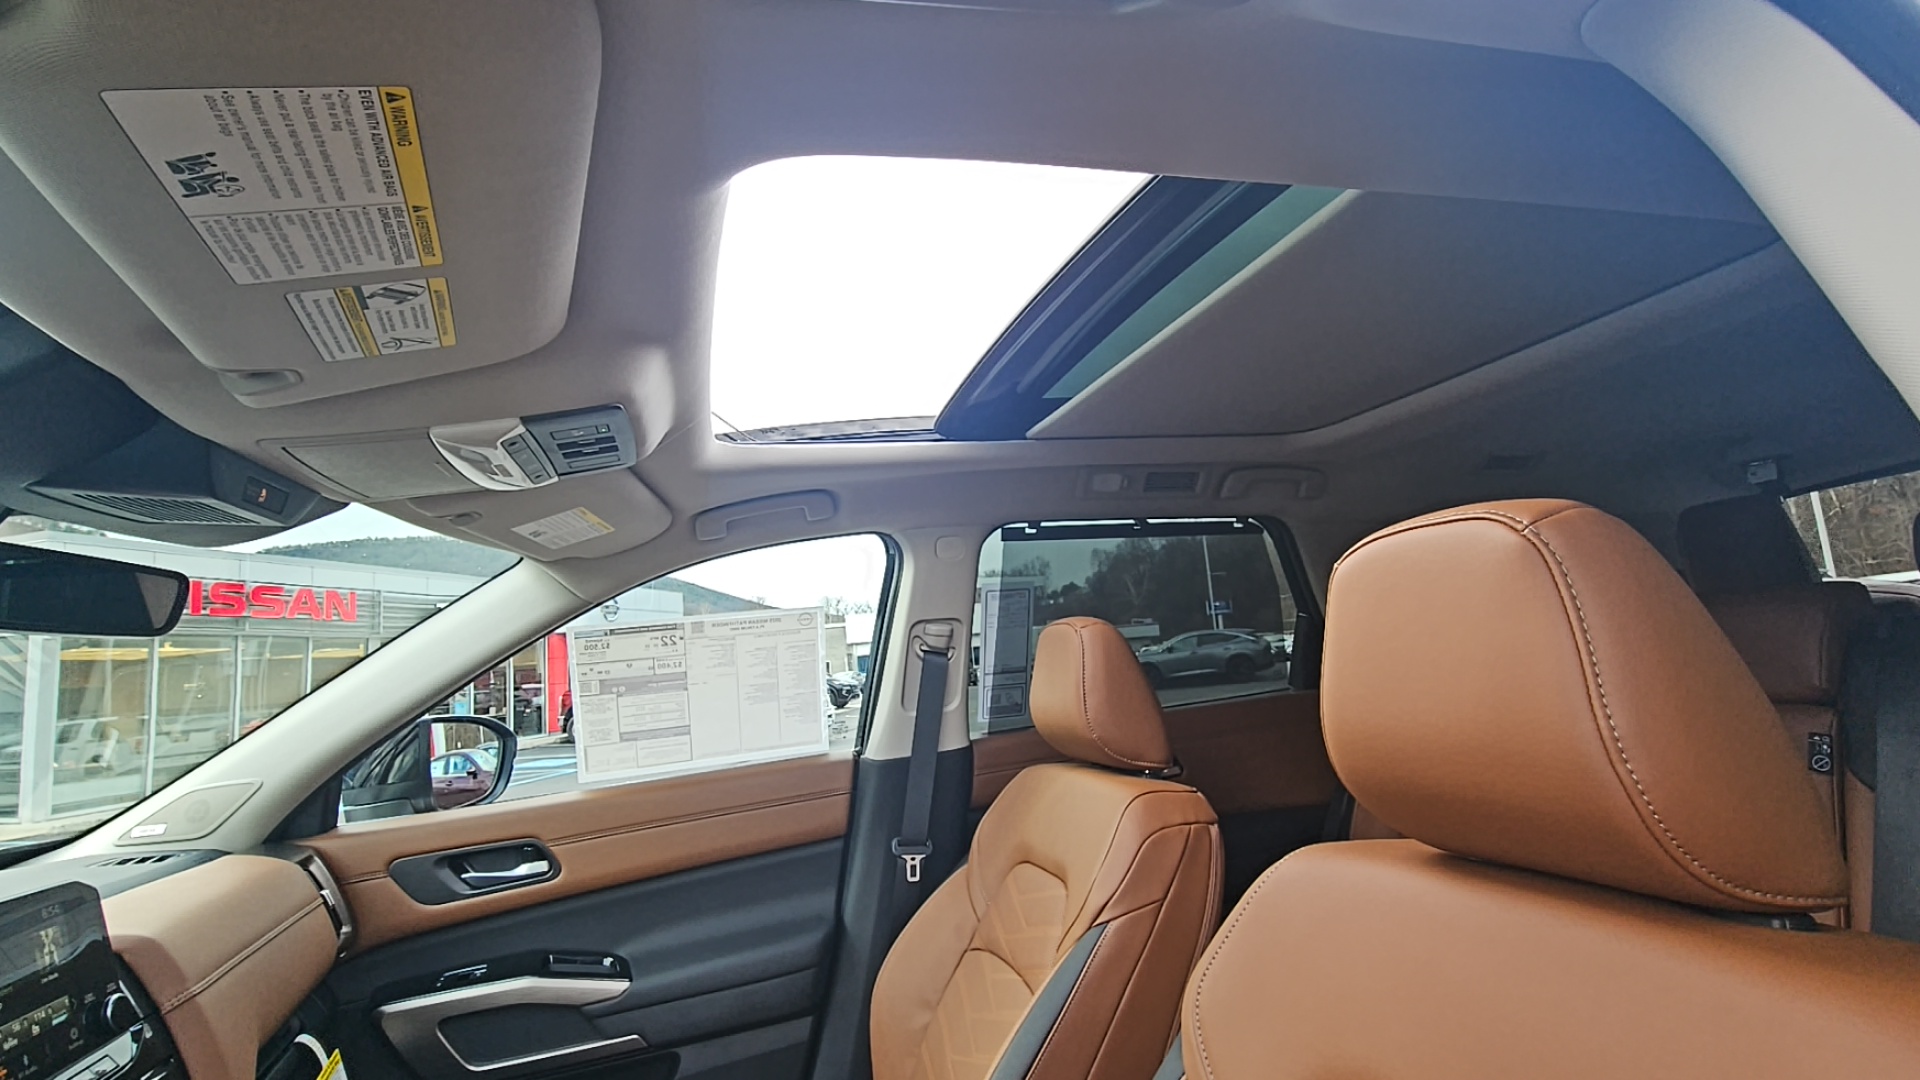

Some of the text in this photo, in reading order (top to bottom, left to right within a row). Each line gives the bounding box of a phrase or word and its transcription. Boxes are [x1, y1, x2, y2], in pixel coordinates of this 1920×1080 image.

[222, 94, 238, 106] See
[246, 95, 264, 115] Always
[273, 93, 289, 111] Never
[299, 93, 312, 105] The
[338, 93, 354, 117] Children
[303, 106, 317, 119] back
[326, 101, 337, 111] the
[204, 95, 233, 136] about air bags
[228, 108, 246, 130] owner's
[258, 116, 269, 126] use
[279, 112, 293, 122] put
[309, 120, 322, 133] seat
[330, 120, 344, 131] bag
[345, 118, 355, 128] can
[390, 105, 412, 146] WARNING
[263, 127, 275, 139] seat
[240, 131, 257, 151] manual
[269, 140, 281, 153] belts
[285, 128, 307, 156] rear-facing
[358, 89, 398, 196] EVEN WITH ADVANCED AIR BAGS
[251, 152, 261, 160] for
[276, 154, 286, 164] and
[300, 157, 312, 168] child
[255, 160, 267, 173] more
[281, 165, 292, 176] child
[323, 164, 337, 176] place
[262, 174, 281, 199] information
[416, 214, 435, 257] AVERTISSEMENT
[189, 580, 357, 622] ISSAN
